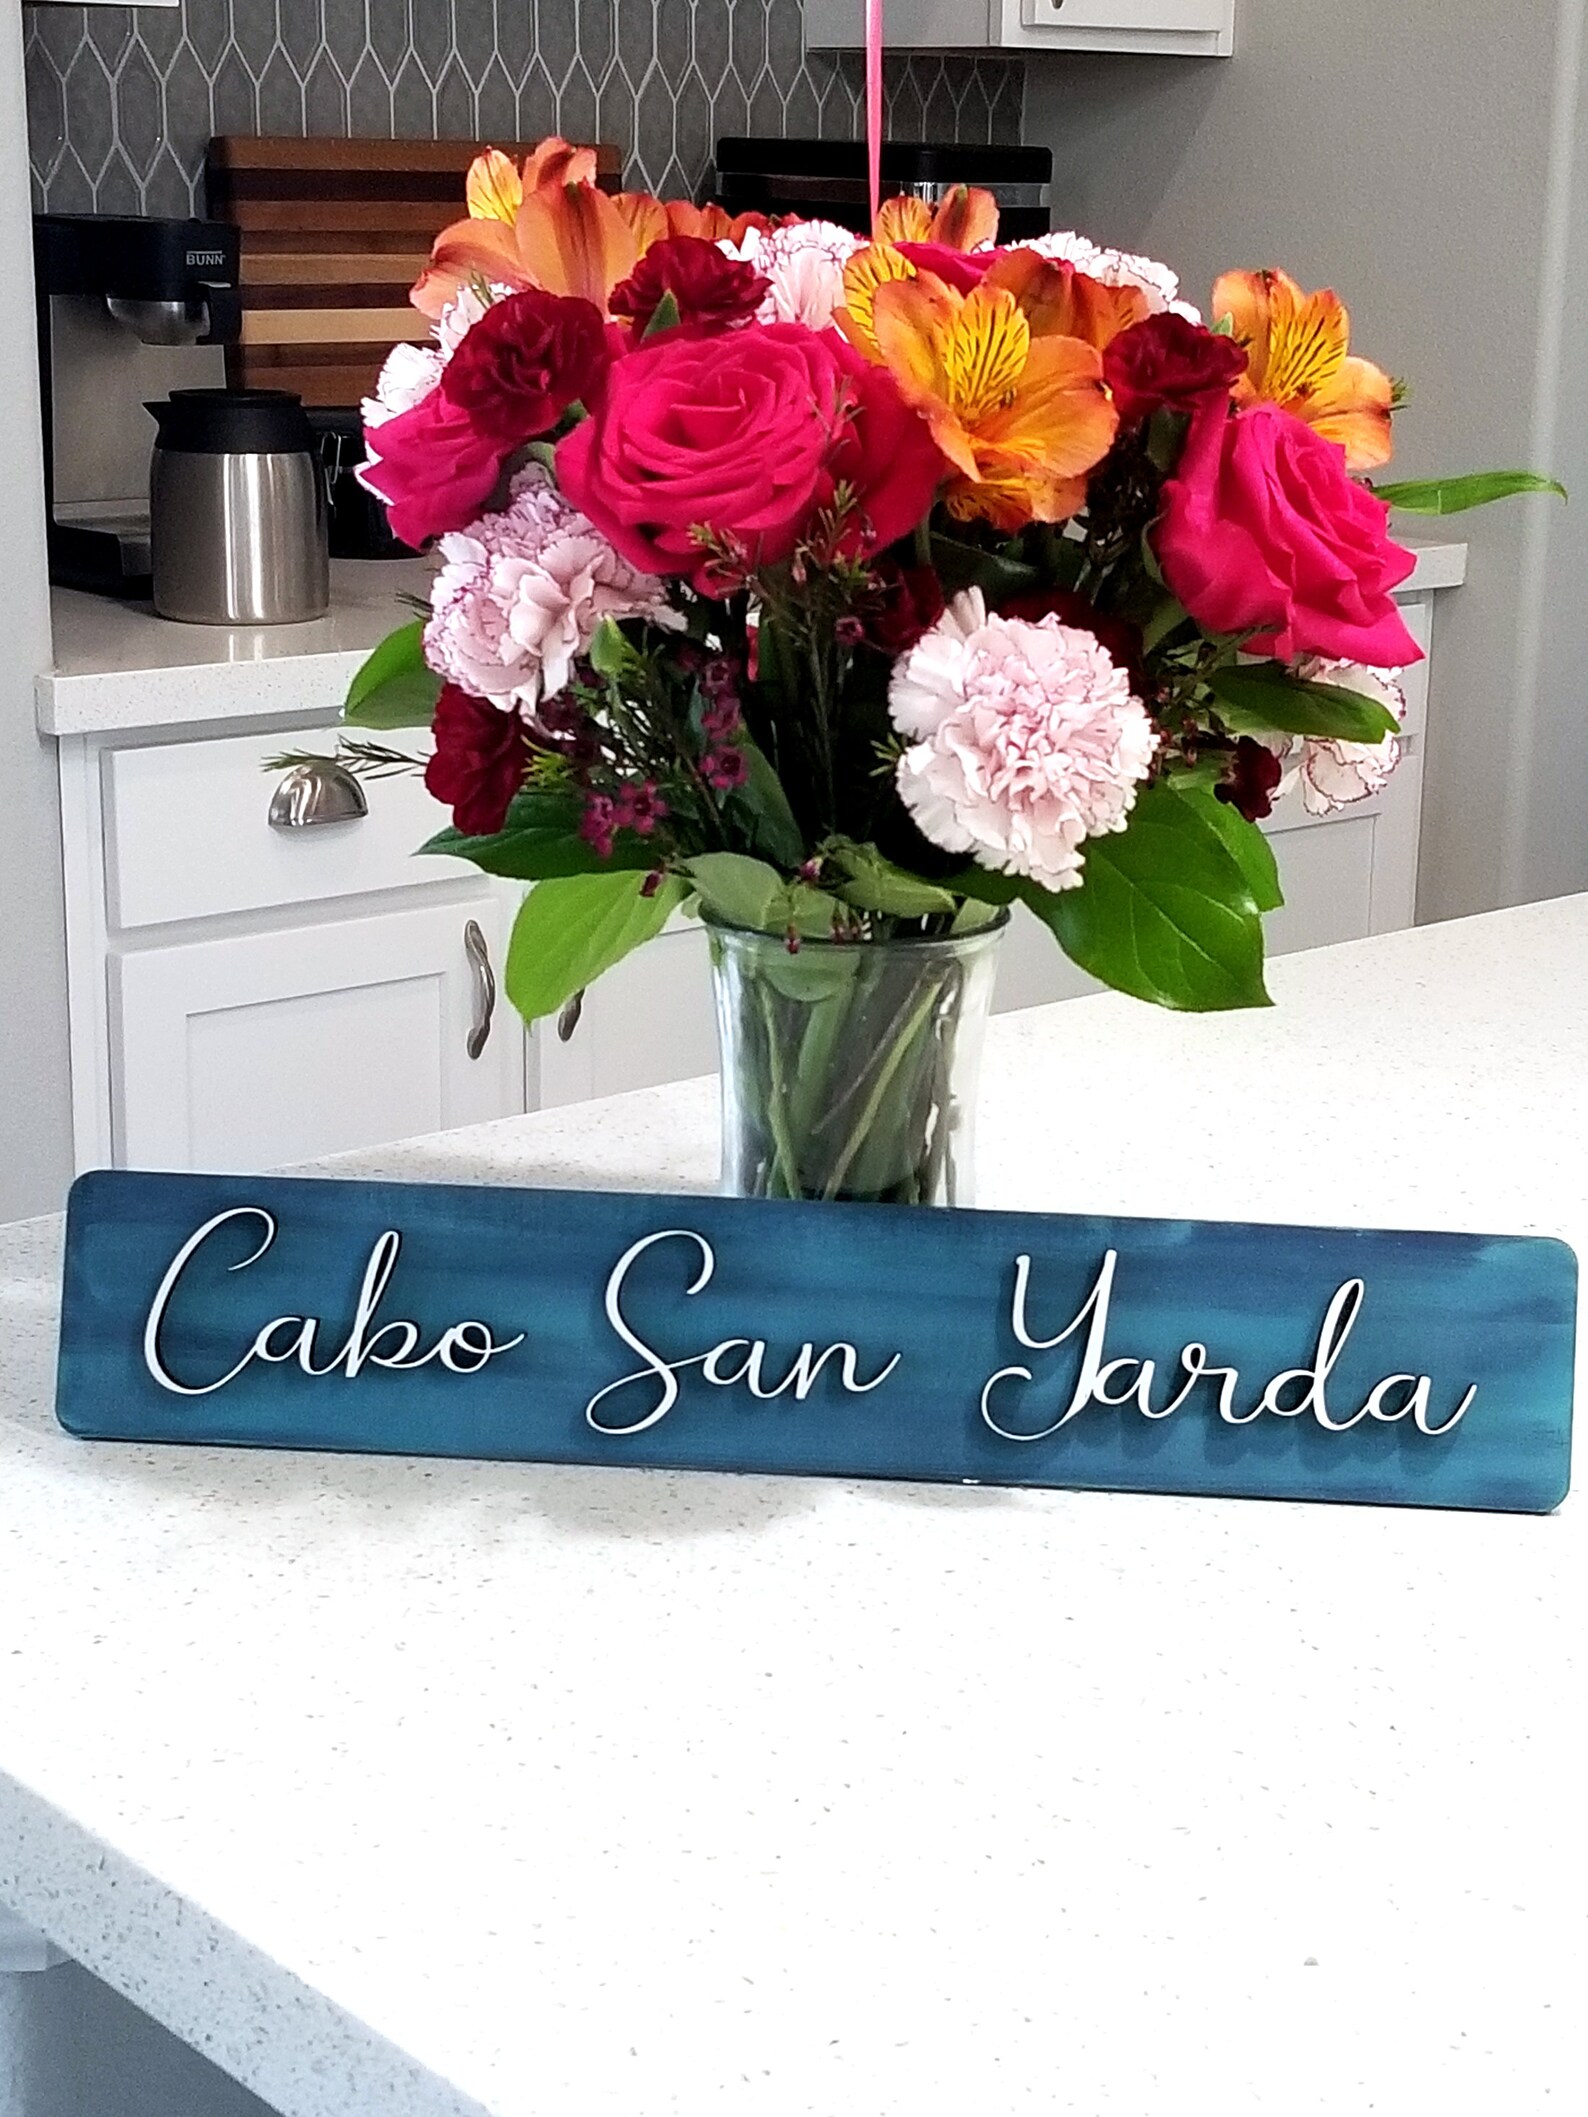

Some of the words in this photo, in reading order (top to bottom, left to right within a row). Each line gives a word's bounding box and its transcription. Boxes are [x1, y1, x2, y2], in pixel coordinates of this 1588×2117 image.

[186, 254, 224, 266] BUNN
[143, 1206, 525, 1396] Cabo
[585, 1229, 902, 1435] San
[980, 1248, 1478, 1442] Yarda
